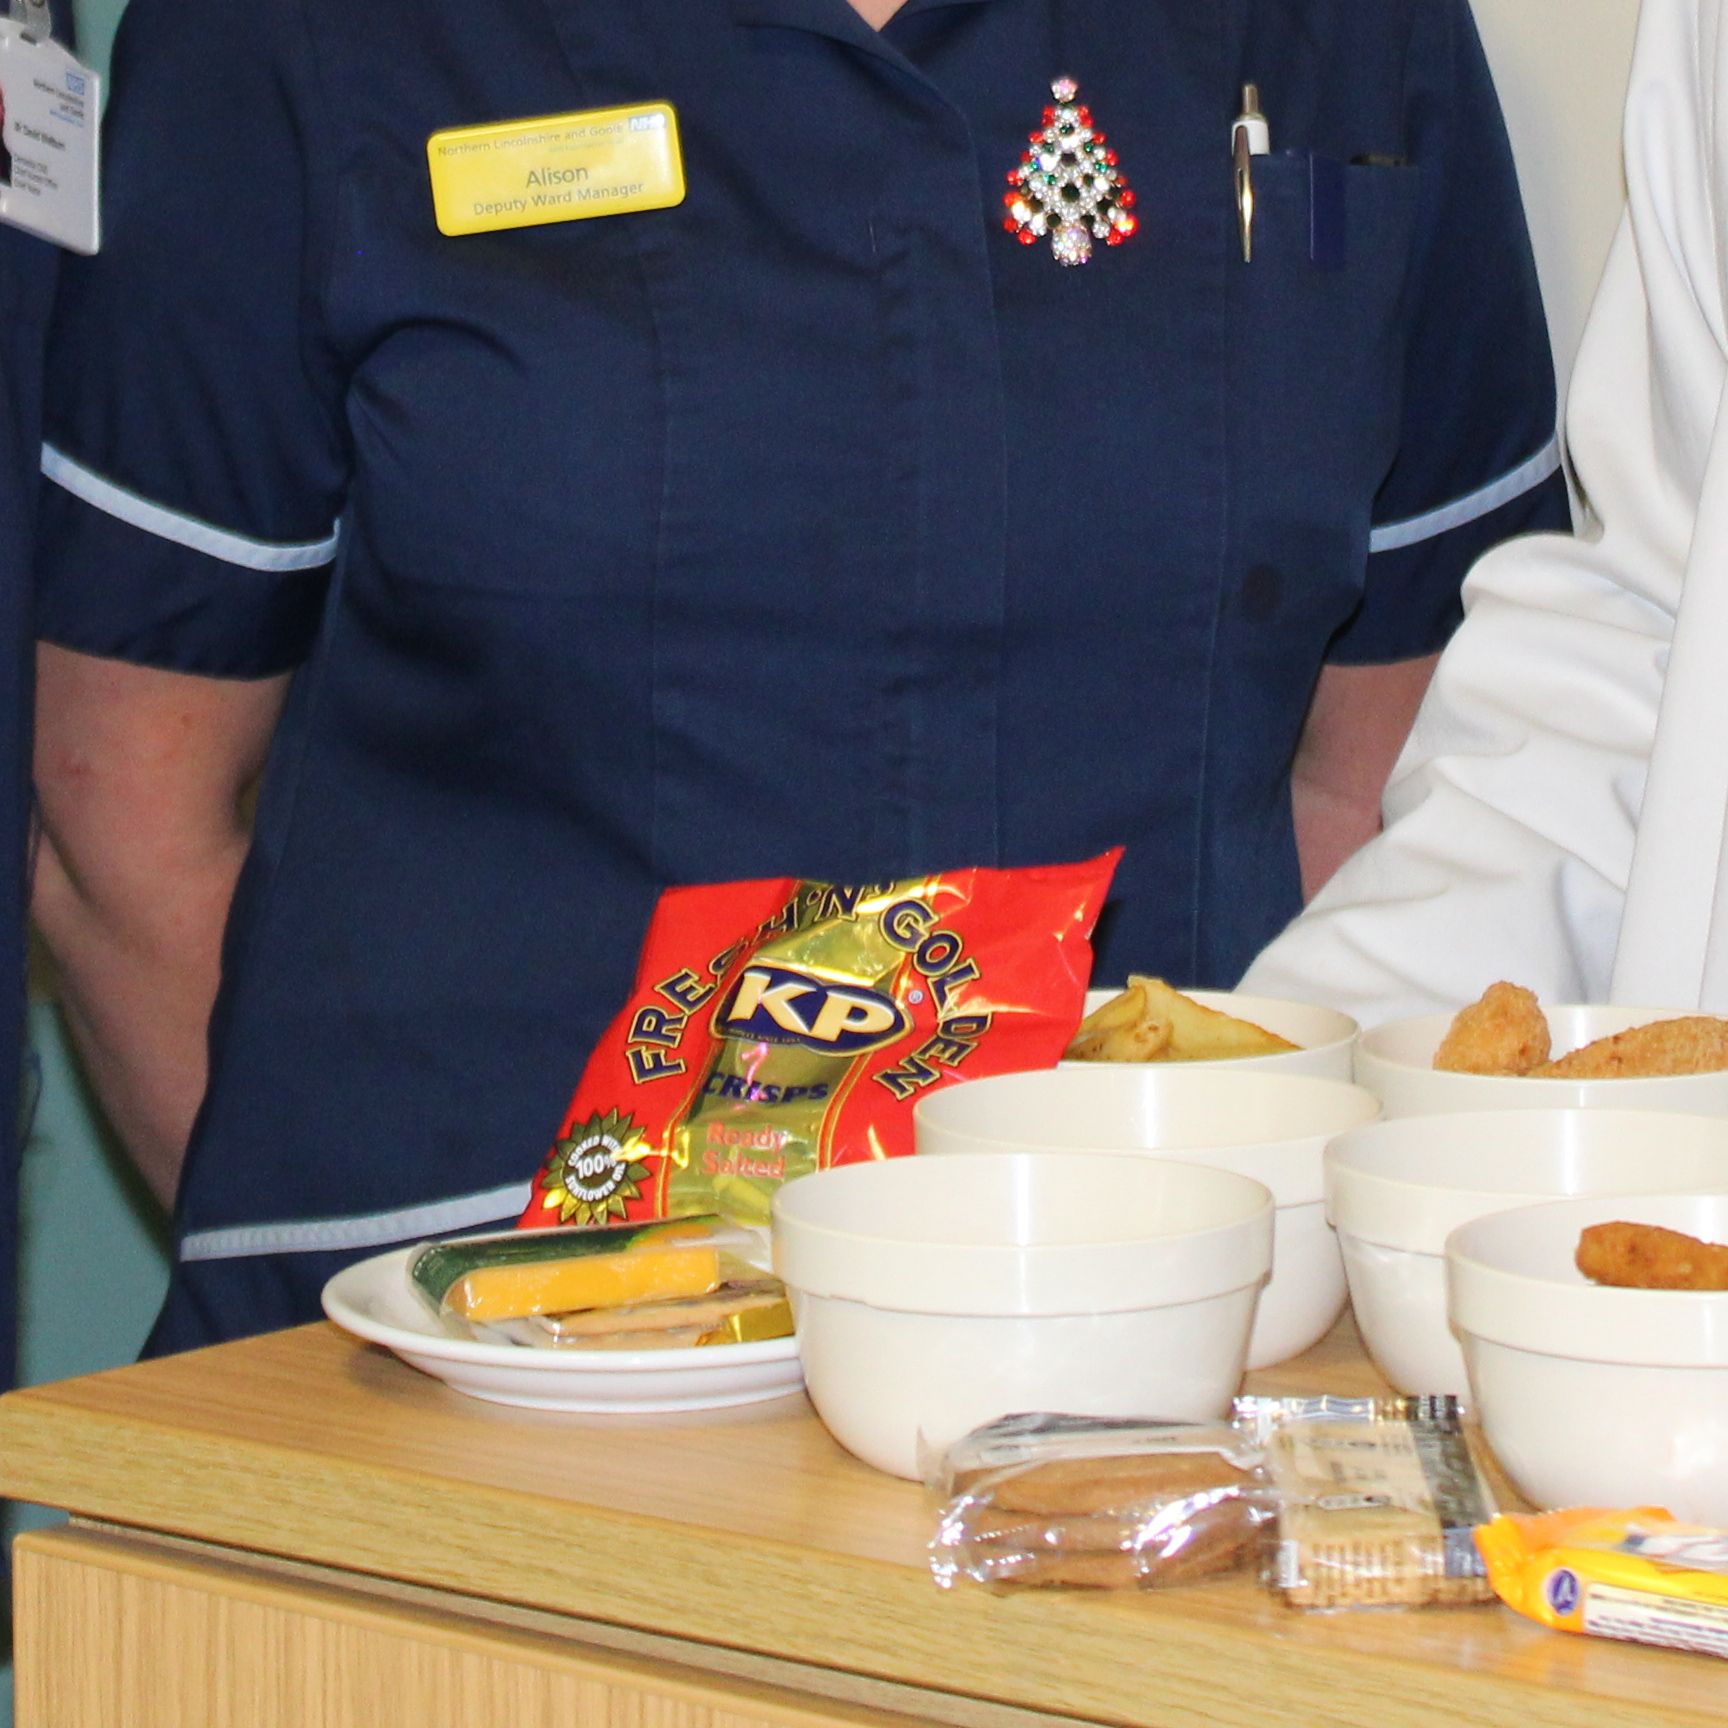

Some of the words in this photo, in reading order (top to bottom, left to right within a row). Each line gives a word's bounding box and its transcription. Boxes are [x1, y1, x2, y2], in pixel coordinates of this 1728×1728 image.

[438, 140, 491, 157] Northern
[493, 132, 561, 151] Lincolnshire
[564, 126, 586, 140] and
[588, 123, 622, 138] Goole
[525, 166, 589, 189] Alison
[473, 192, 528, 216] Deputy
[530, 190, 573, 208] Ward
[577, 181, 645, 202] Manager
[729, 969, 898, 1043] KP
[873, 897, 993, 1100] GOLDEN
[701, 1072, 829, 1104] CRISPS
[567, 1135, 600, 1167] COOKED
[706, 1121, 788, 1154] Ready
[702, 1149, 786, 1179] Salted
[565, 1174, 616, 1202] SUNFLOWER
